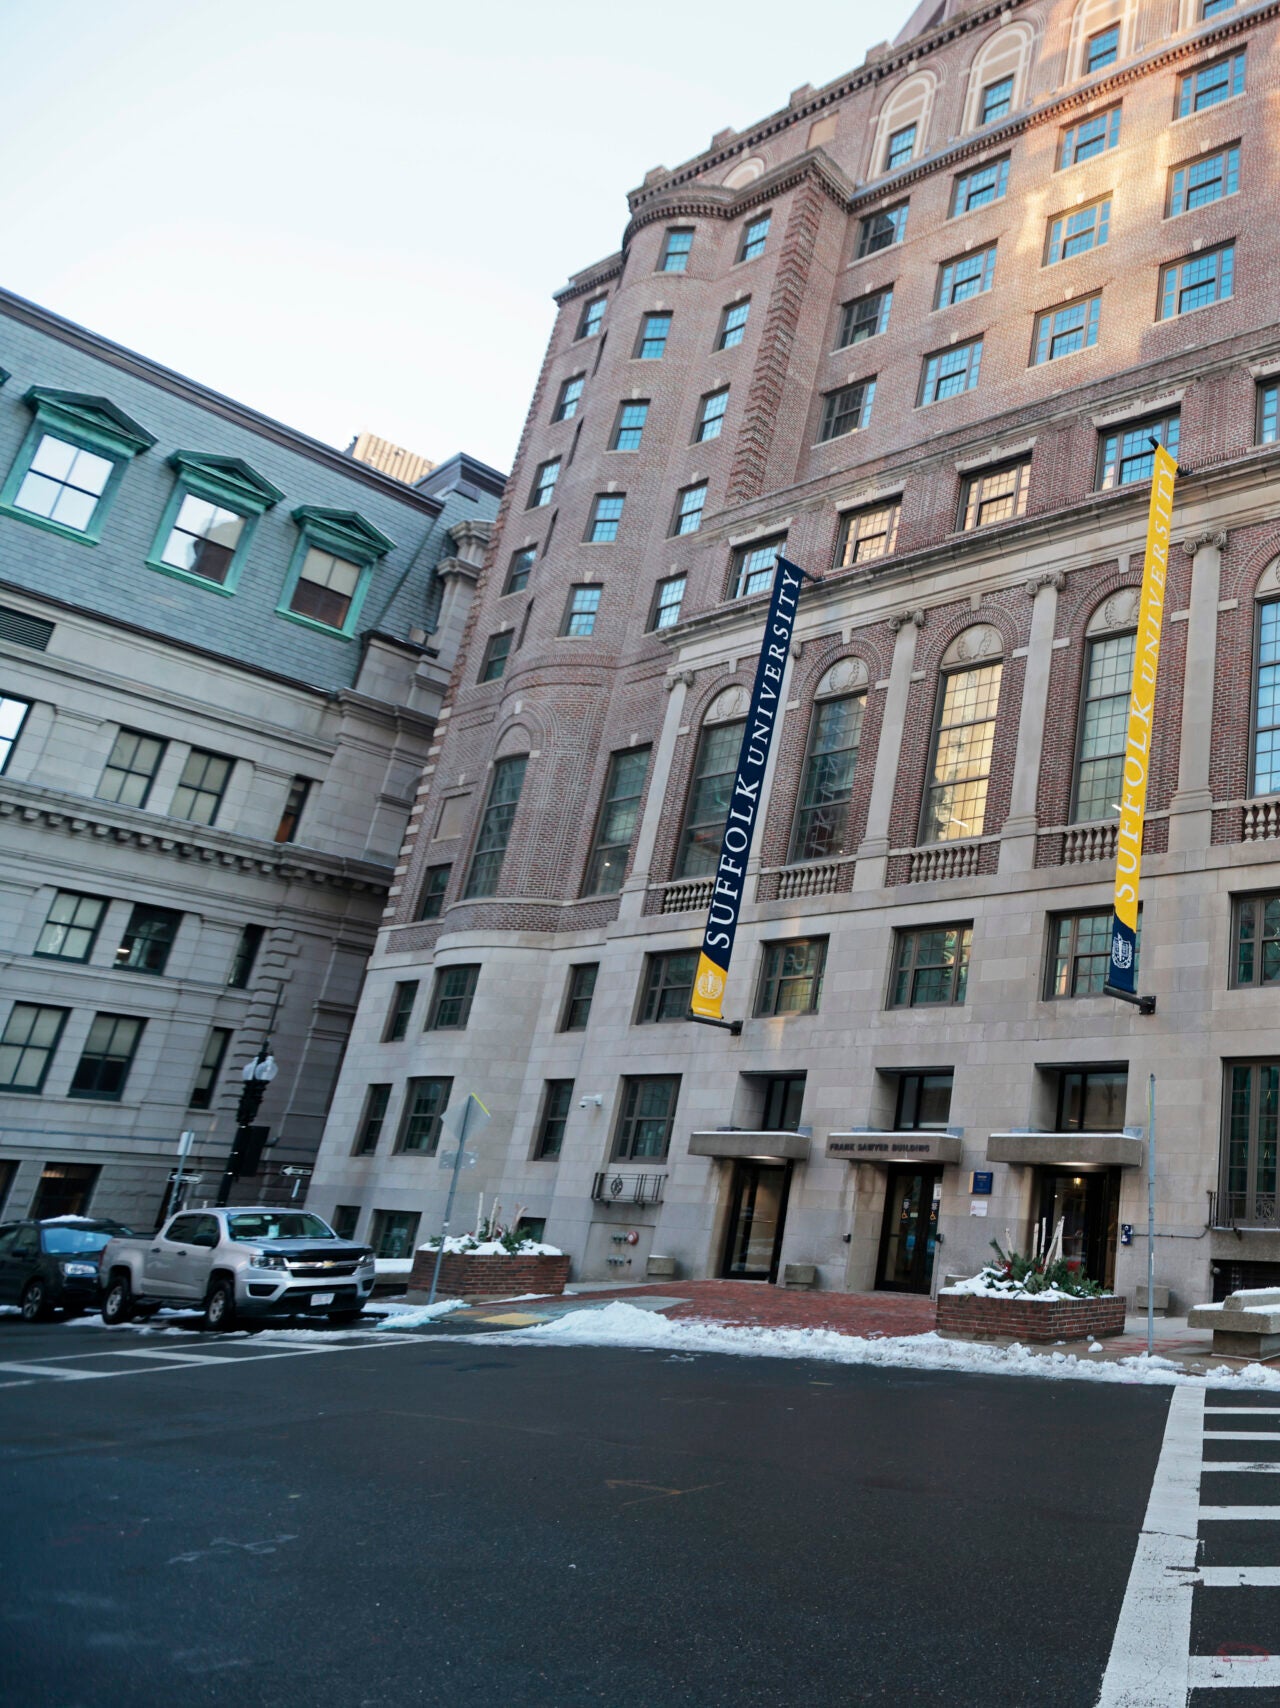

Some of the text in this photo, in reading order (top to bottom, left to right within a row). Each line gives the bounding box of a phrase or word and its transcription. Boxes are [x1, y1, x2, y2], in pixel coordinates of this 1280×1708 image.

[706, 568, 800, 949] SUFFOLK UNIVERSITY
[1115, 465, 1174, 904] SUFFOLK UNIVERSITY
[830, 1143, 930, 1153] FRANK SAWYER BUILDING
